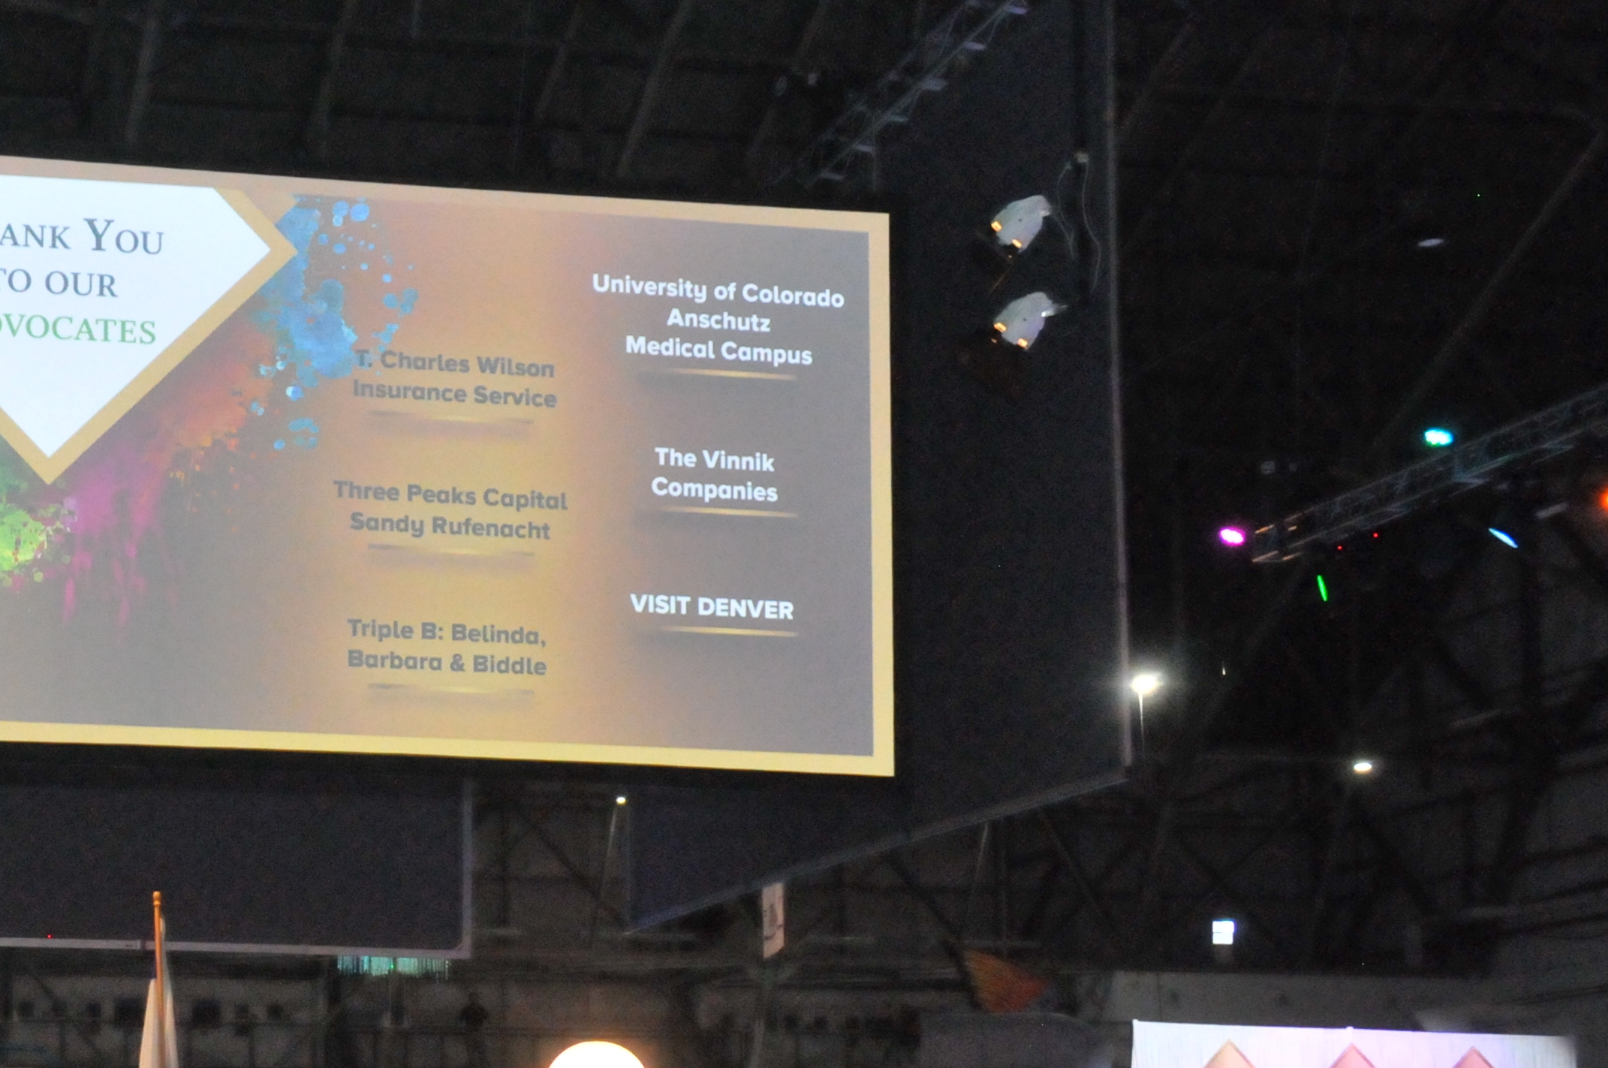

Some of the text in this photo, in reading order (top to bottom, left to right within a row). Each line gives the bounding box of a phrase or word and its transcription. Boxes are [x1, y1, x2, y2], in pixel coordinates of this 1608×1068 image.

[592, 273, 845, 308] University of Colorado
[667, 307, 771, 333] Anschutz
[355, 349, 555, 378] T. Charles Wilson
[625, 335, 813, 366] Medical Campus
[353, 378, 558, 409] Insurance Service
[655, 446, 775, 473] The Vinnik
[334, 479, 568, 513] Three Peaks Capital
[651, 477, 779, 503] Companies
[350, 511, 551, 541] Sandy Rufenacht
[630, 593, 795, 621] VISIT DENVER
[347, 617, 547, 649] Triple B: Belinda,
[347, 648, 547, 677] Barbara & Biddle
